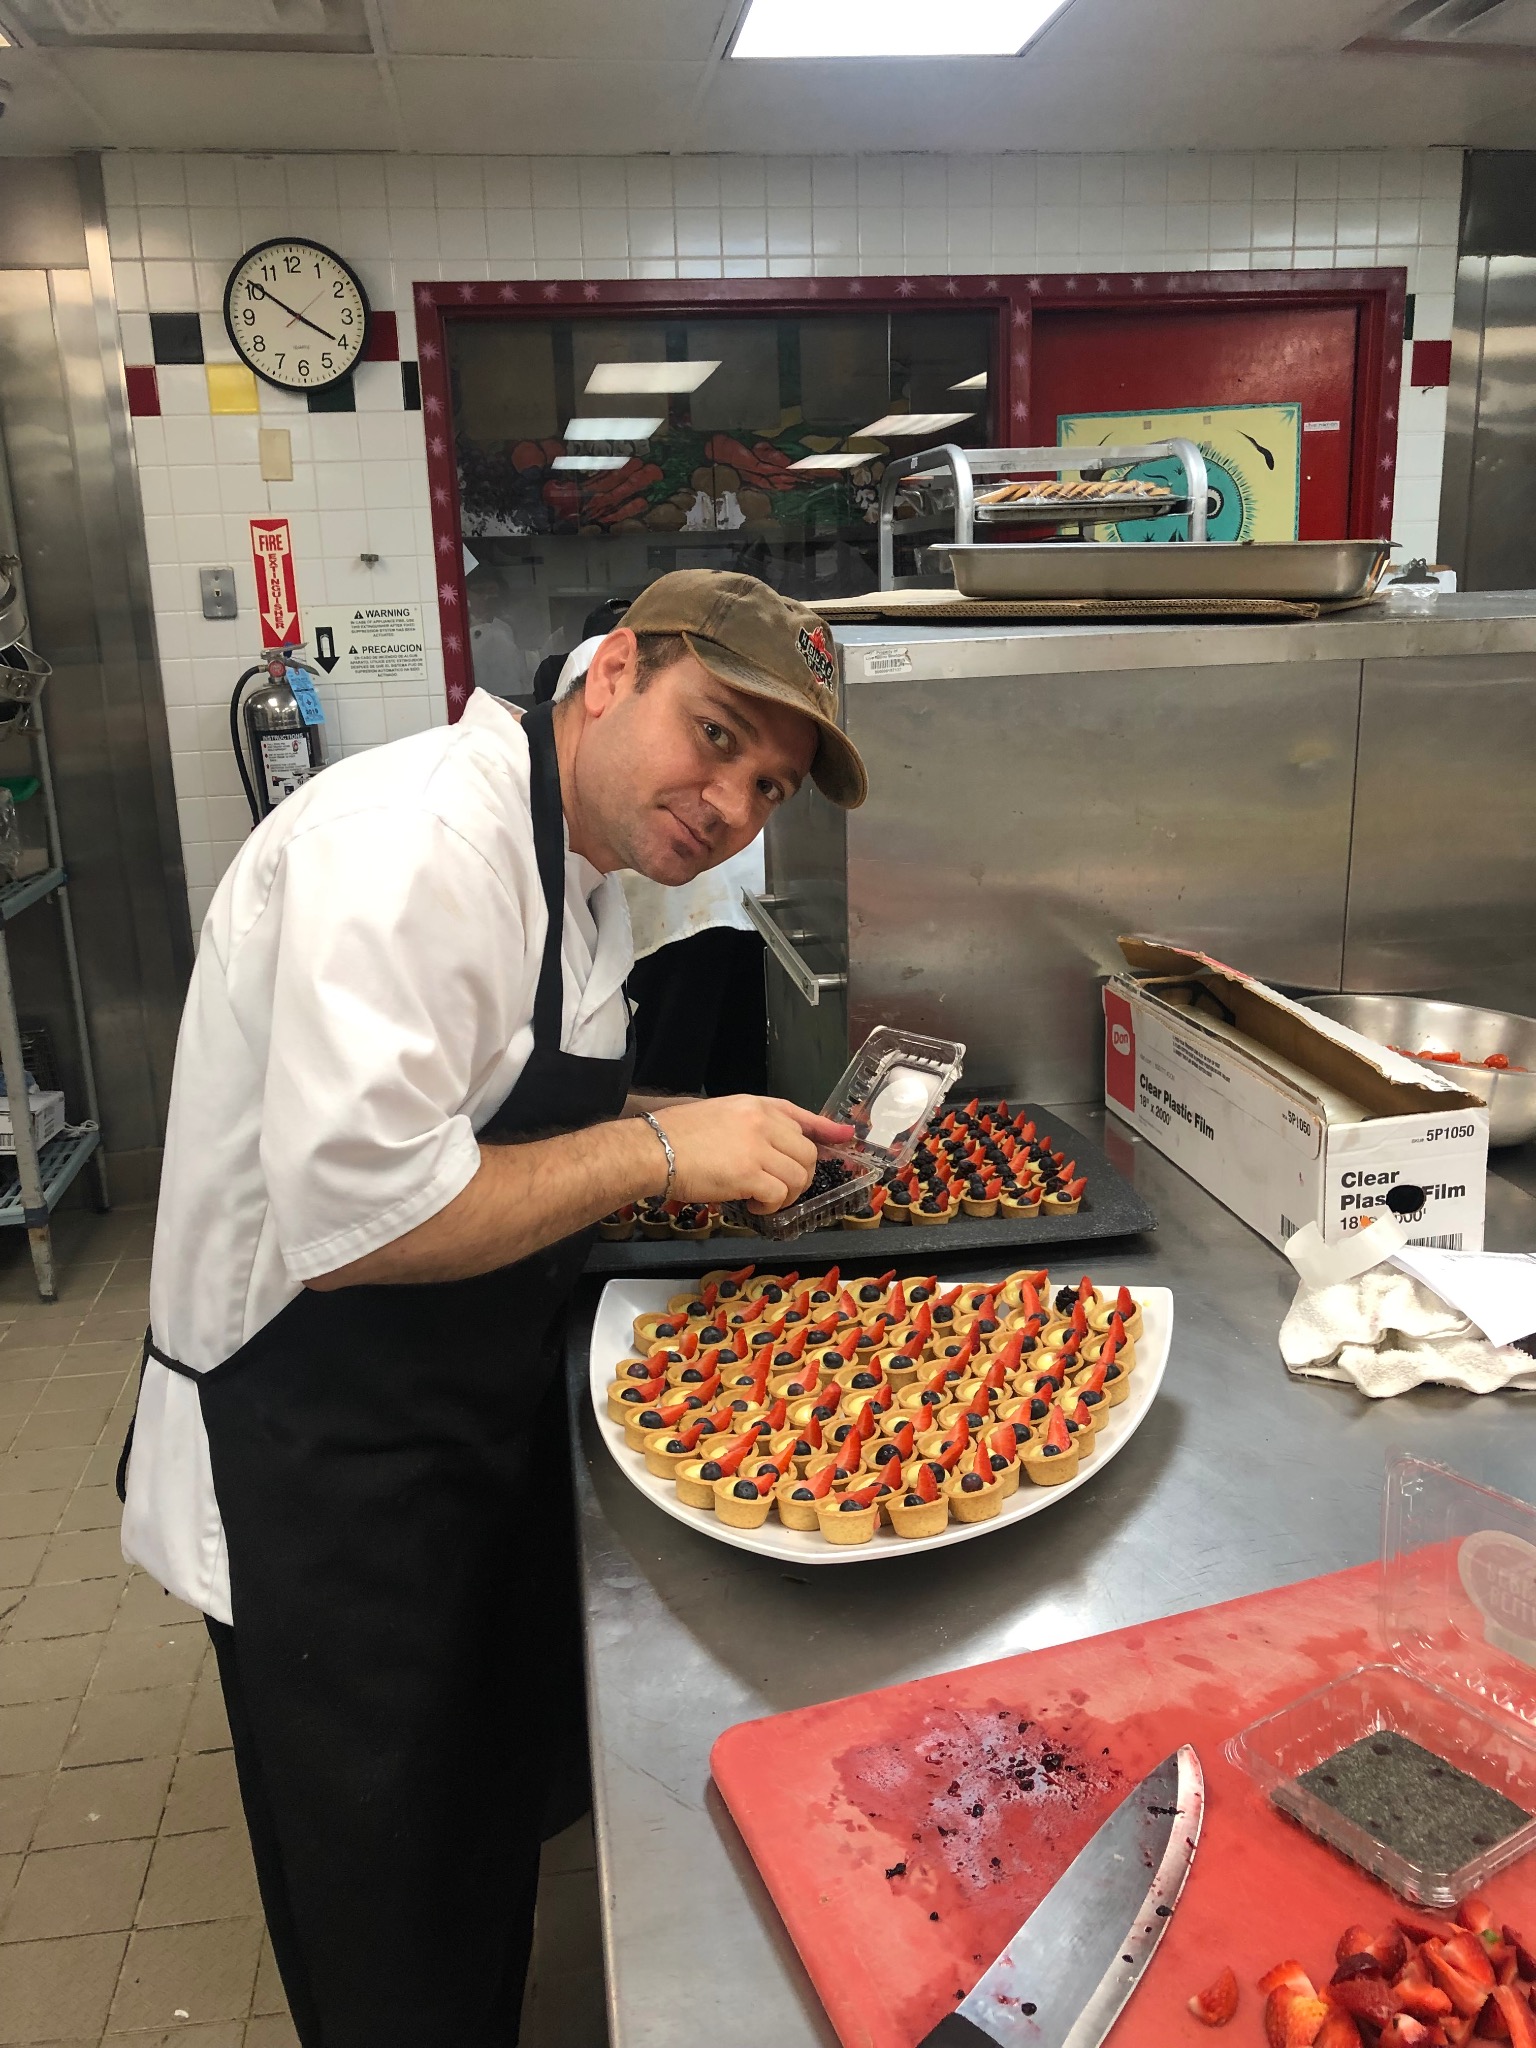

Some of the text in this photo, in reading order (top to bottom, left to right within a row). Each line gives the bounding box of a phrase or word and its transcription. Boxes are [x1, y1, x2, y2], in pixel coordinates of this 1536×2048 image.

[261, 265, 276, 281] 11
[283, 256, 301, 274] 12
[314, 263, 321, 278] 1
[245, 283, 265, 300] 10
[333, 281, 344, 298] 2
[243, 309, 255, 326] 9
[341, 308, 353, 325] 3
[253, 335, 265, 352] 8
[338, 334, 349, 350] 4
[275, 354, 285, 369] 7
[298, 360, 309, 376] 6
[321, 352, 333, 368] 5
[259, 534, 283, 551] FIRE
[268, 554, 285, 629] EXTINGUISHER
[366, 608, 410, 618] WARNING
[362, 644, 422, 654] PRECAUCION
[263, 733, 303, 741] INSTRUCTIONS
[1140, 1073, 1162, 1100] Clear
[1164, 1090, 1192, 1124] Plastic
[1194, 1112, 1214, 1140] Film
[1150, 1104, 1155, 1114] x
[1288, 1110, 1311, 1136] 5P1050
[1426, 1124, 1475, 1142] 5P1050
[1341, 1170, 1400, 1188] Clear
[1422, 1184, 1466, 1200] Film
